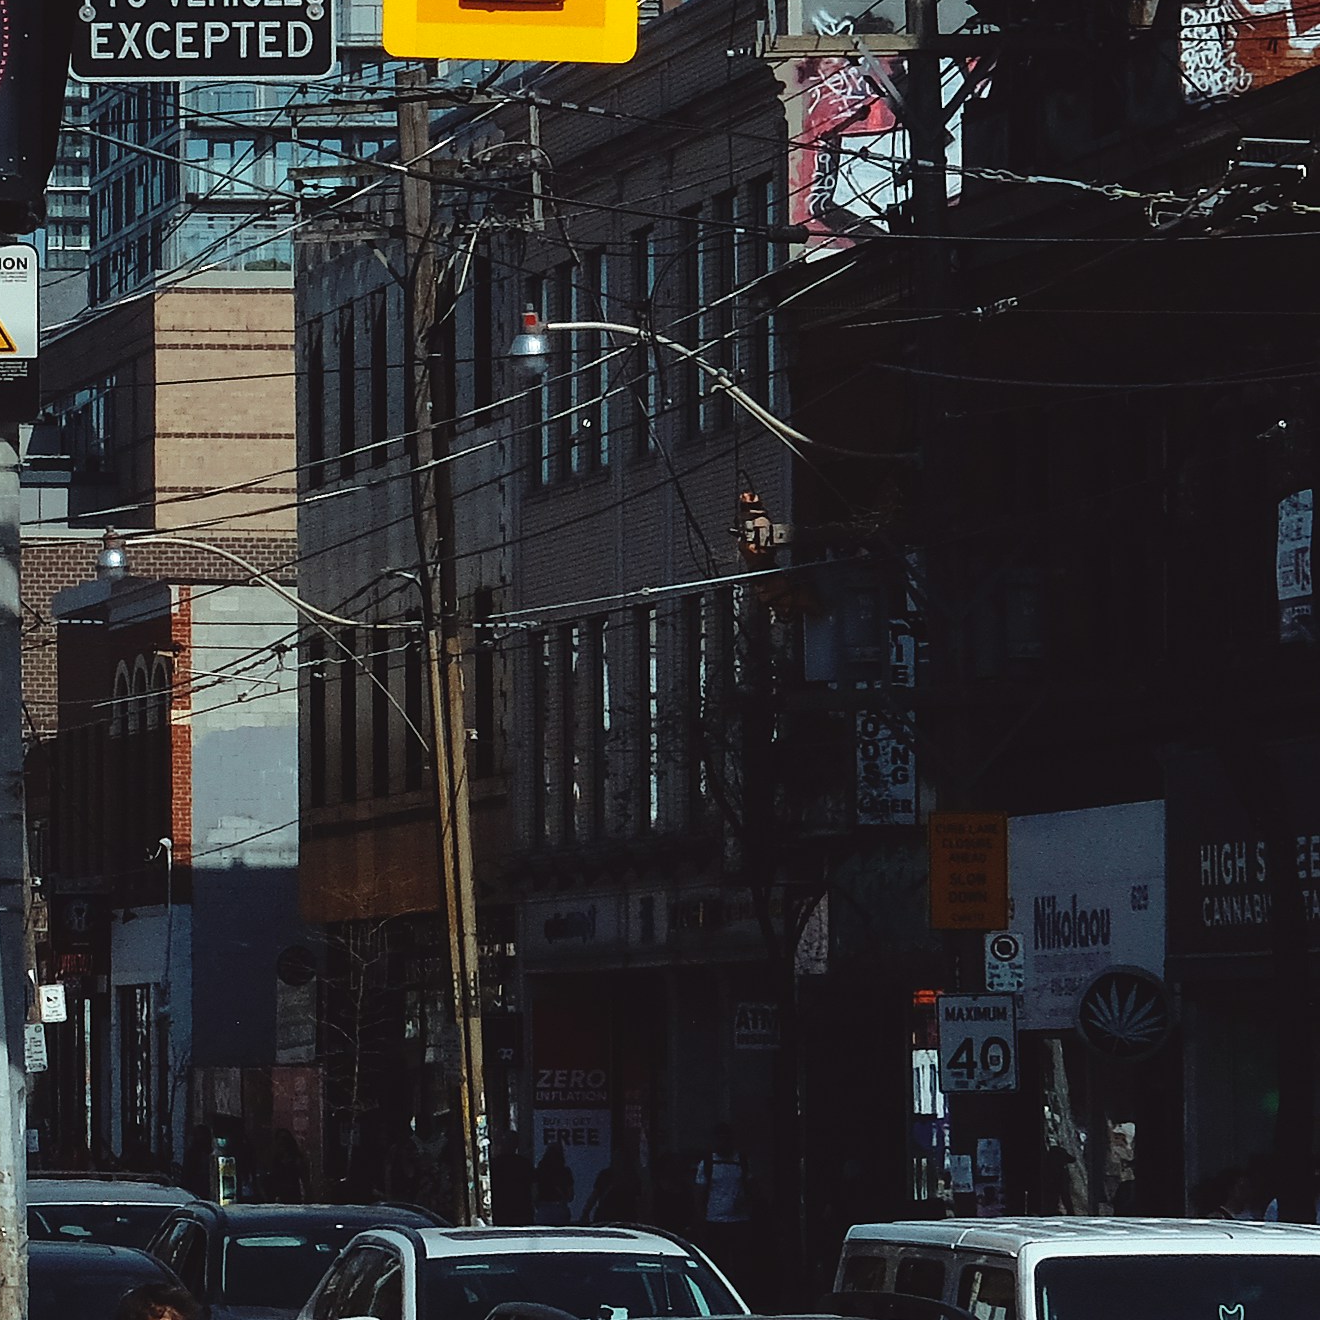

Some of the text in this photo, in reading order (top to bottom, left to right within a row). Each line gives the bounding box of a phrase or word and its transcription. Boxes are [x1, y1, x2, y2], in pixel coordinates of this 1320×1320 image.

[90, 20, 314, 60] EXCEPTED
[1201, 840, 1248, 885] HIGH
[1033, 893, 1111, 950] Nikolaou
[1202, 893, 1272, 927] CANNABI
[944, 1005, 1008, 1022] MAXIMUM
[946, 1036, 1011, 1080] 40
[535, 1090, 607, 1102] INFLATION
[536, 1069, 607, 1089] ZERO
[542, 1128, 601, 1146] FREE
